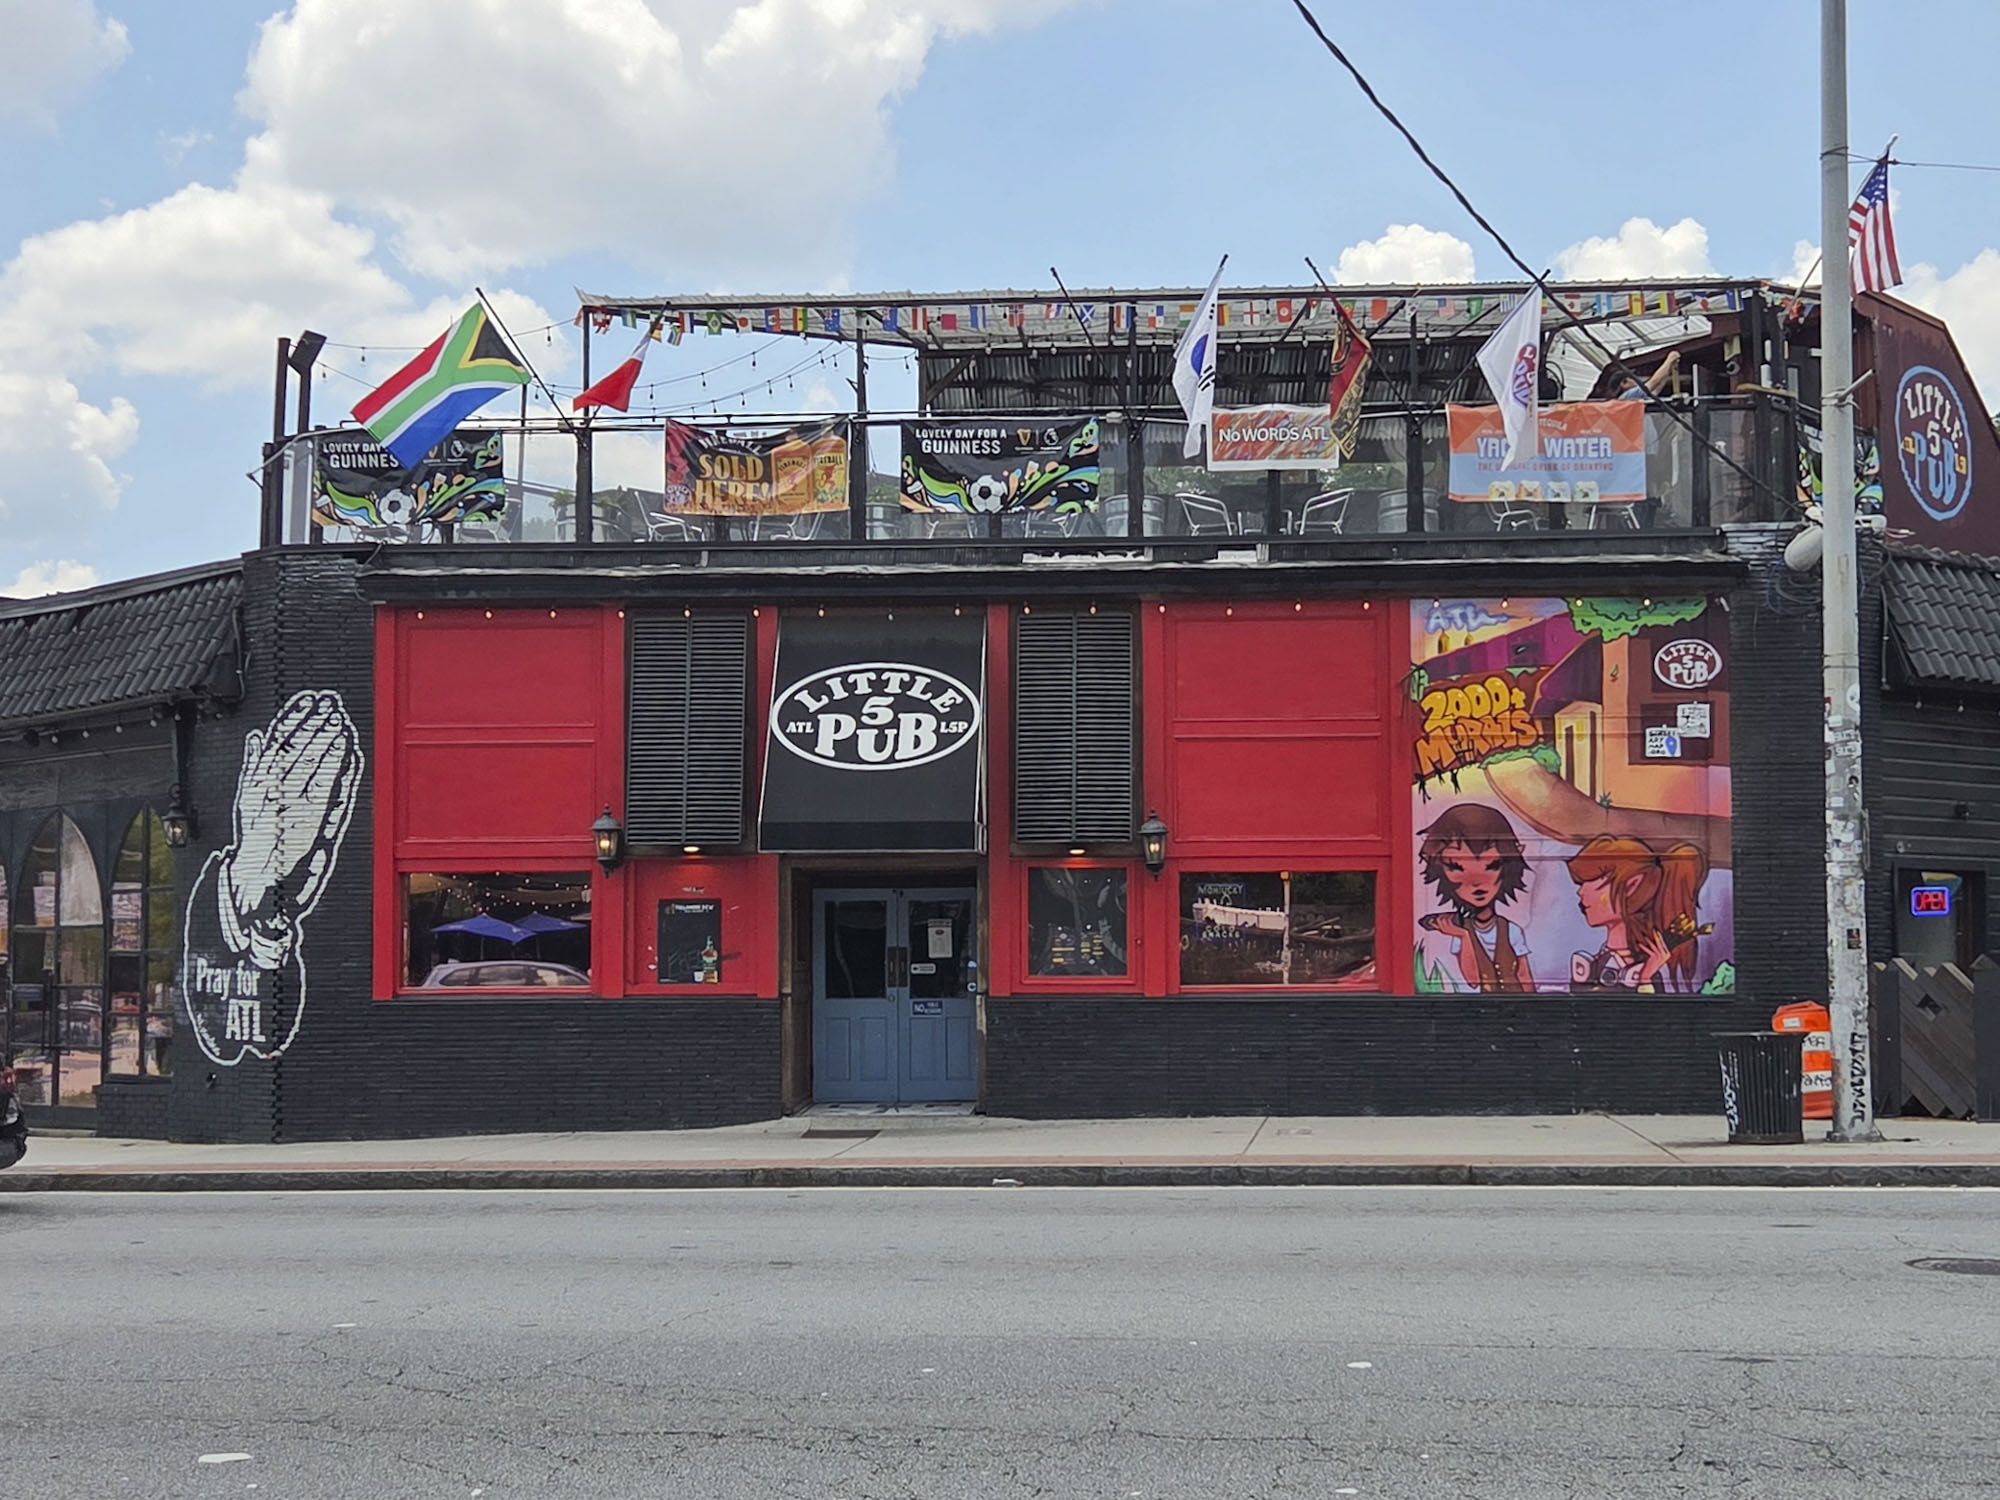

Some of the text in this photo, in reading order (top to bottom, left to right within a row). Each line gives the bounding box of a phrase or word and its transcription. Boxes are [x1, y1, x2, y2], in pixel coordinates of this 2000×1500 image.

[1904, 382, 1963, 442] LITTLE
[916, 428, 1008, 439] LOVELY DAY FOR A
[1242, 426, 1300, 442] WORDS
[1303, 426, 1330, 441] ATL
[1927, 421, 1940, 456] 5
[323, 442, 360, 453] LOVELY
[362, 442, 382, 453] DAY
[921, 439, 1002, 455] GUINNESS
[1543, 436, 1613, 459] WATER
[330, 453, 400, 469] GUINNES
[698, 454, 764, 480] SOLD
[1911, 431, 1957, 505] PUB
[695, 478, 770, 506] HERE!
[1660, 643, 1715, 663] LITTLE
[1682, 655, 1694, 669] 5
[1668, 661, 1709, 685] PUB
[794, 671, 964, 714] LITTLE
[860, 695, 895, 726] 5
[785, 712, 969, 763] ATL PUB L5P
[195, 957, 261, 1002] Pray for
[224, 998, 267, 1042] ATL
